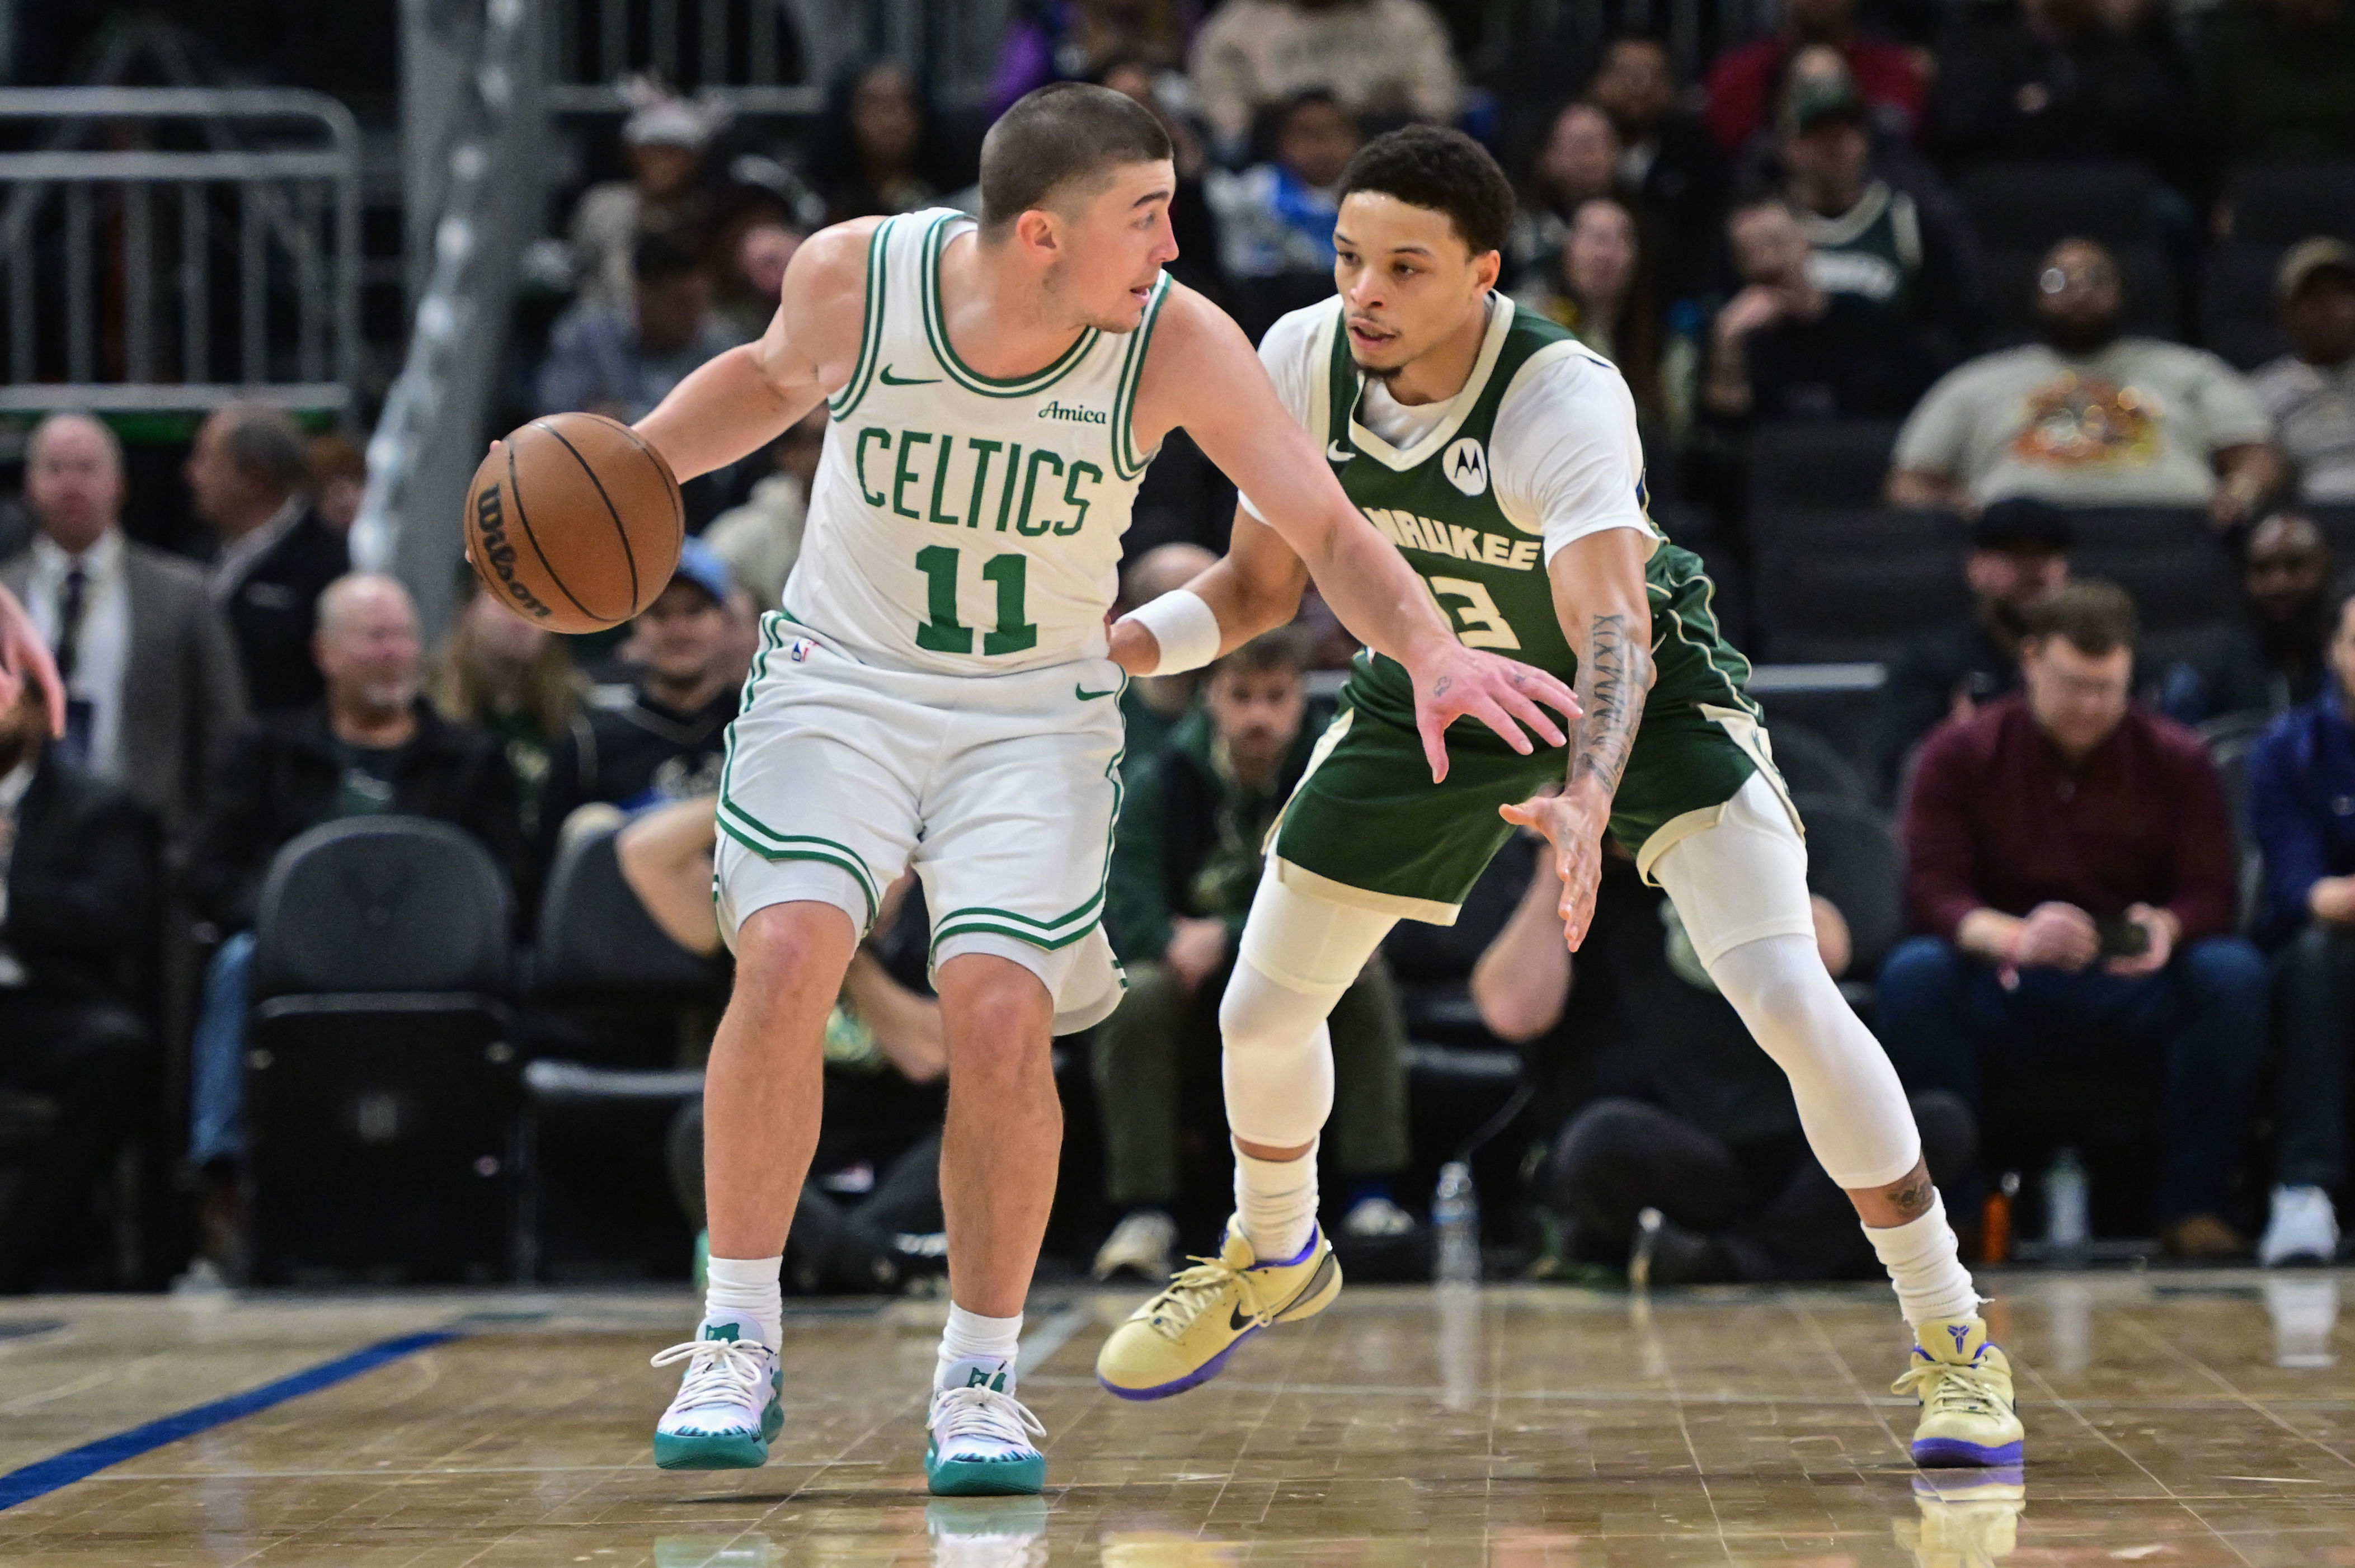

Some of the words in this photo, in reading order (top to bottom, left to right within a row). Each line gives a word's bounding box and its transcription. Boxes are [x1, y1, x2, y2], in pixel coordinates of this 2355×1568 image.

[1038, 401, 1106, 424] Amica
[857, 427, 1102, 536] CELTICS
[478, 482, 552, 616] Wilson
[1361, 506, 1541, 571] WAUKEE
[915, 544, 1037, 656] 11
[1416, 572, 1521, 651] 3
